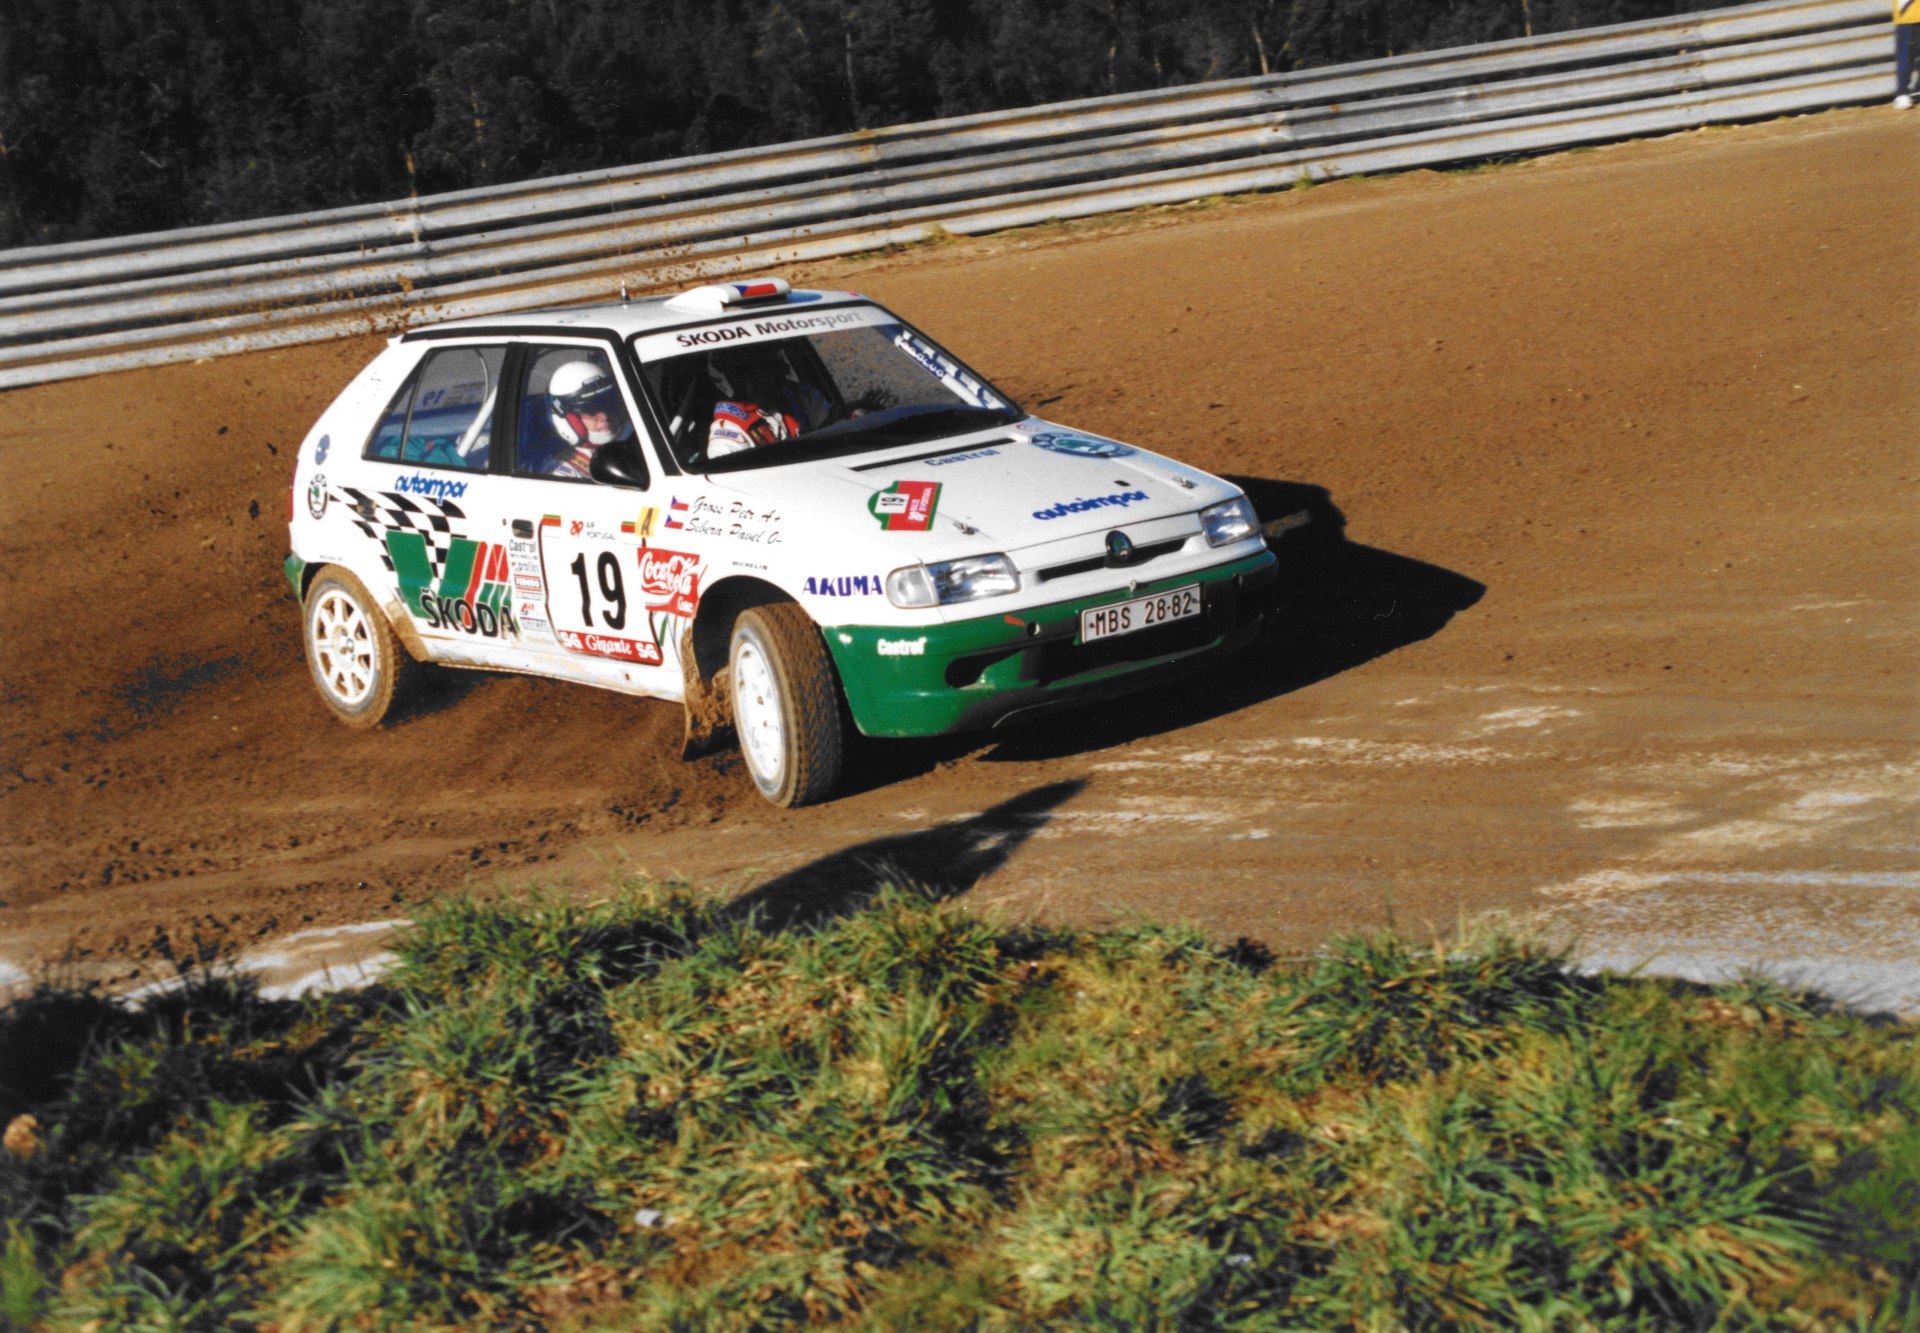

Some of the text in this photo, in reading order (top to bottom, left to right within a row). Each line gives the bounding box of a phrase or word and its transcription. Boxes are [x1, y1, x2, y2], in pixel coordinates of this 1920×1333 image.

[676, 310, 862, 348] ŠKODA Motorsport
[924, 447, 1001, 466] Castrol
[881, 497, 905, 506] 19
[1032, 490, 1150, 520] autoimpor
[729, 523, 766, 543] Pavel
[509, 539, 536, 553] Castrol
[732, 561, 768, 570] MICHELIN
[570, 551, 627, 631] 19
[802, 575, 883, 597] AKUMA
[420, 587, 520, 640] ŠKODA
[1095, 606, 1131, 636] MBS
[560, 632, 660, 660] SG Gigante SG
[877, 636, 927, 656] Castrol
